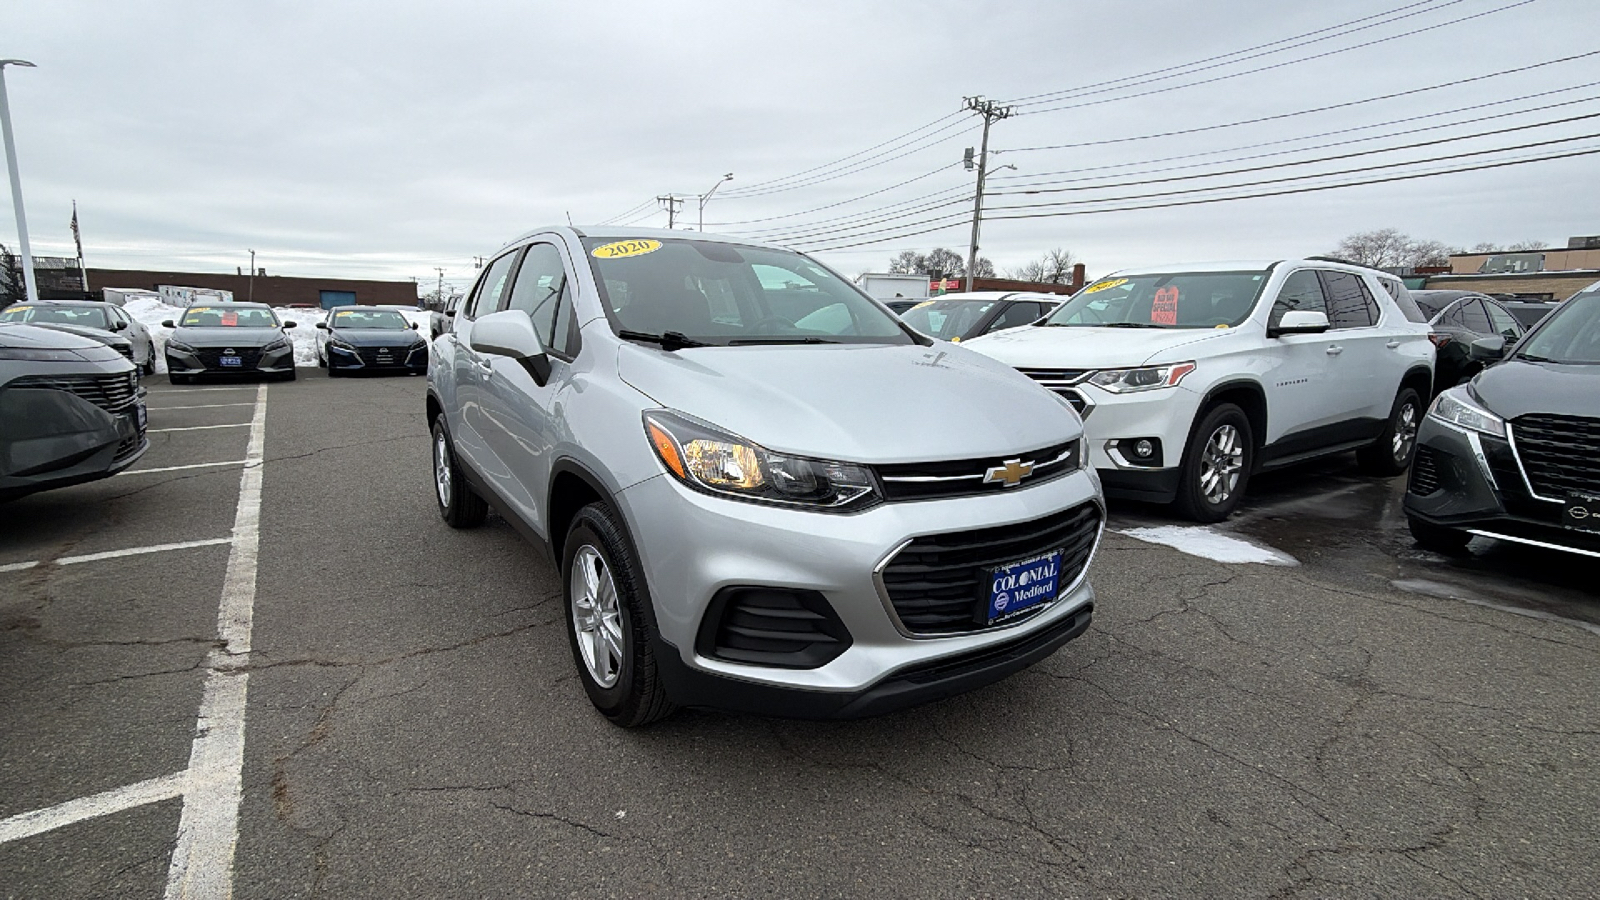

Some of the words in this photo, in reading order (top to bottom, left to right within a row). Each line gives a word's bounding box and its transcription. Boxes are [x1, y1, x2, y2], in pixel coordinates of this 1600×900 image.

[605, 241, 650, 257] 2020
[992, 563, 1058, 594] COLONIAL
[1013, 580, 1053, 603] Medford
